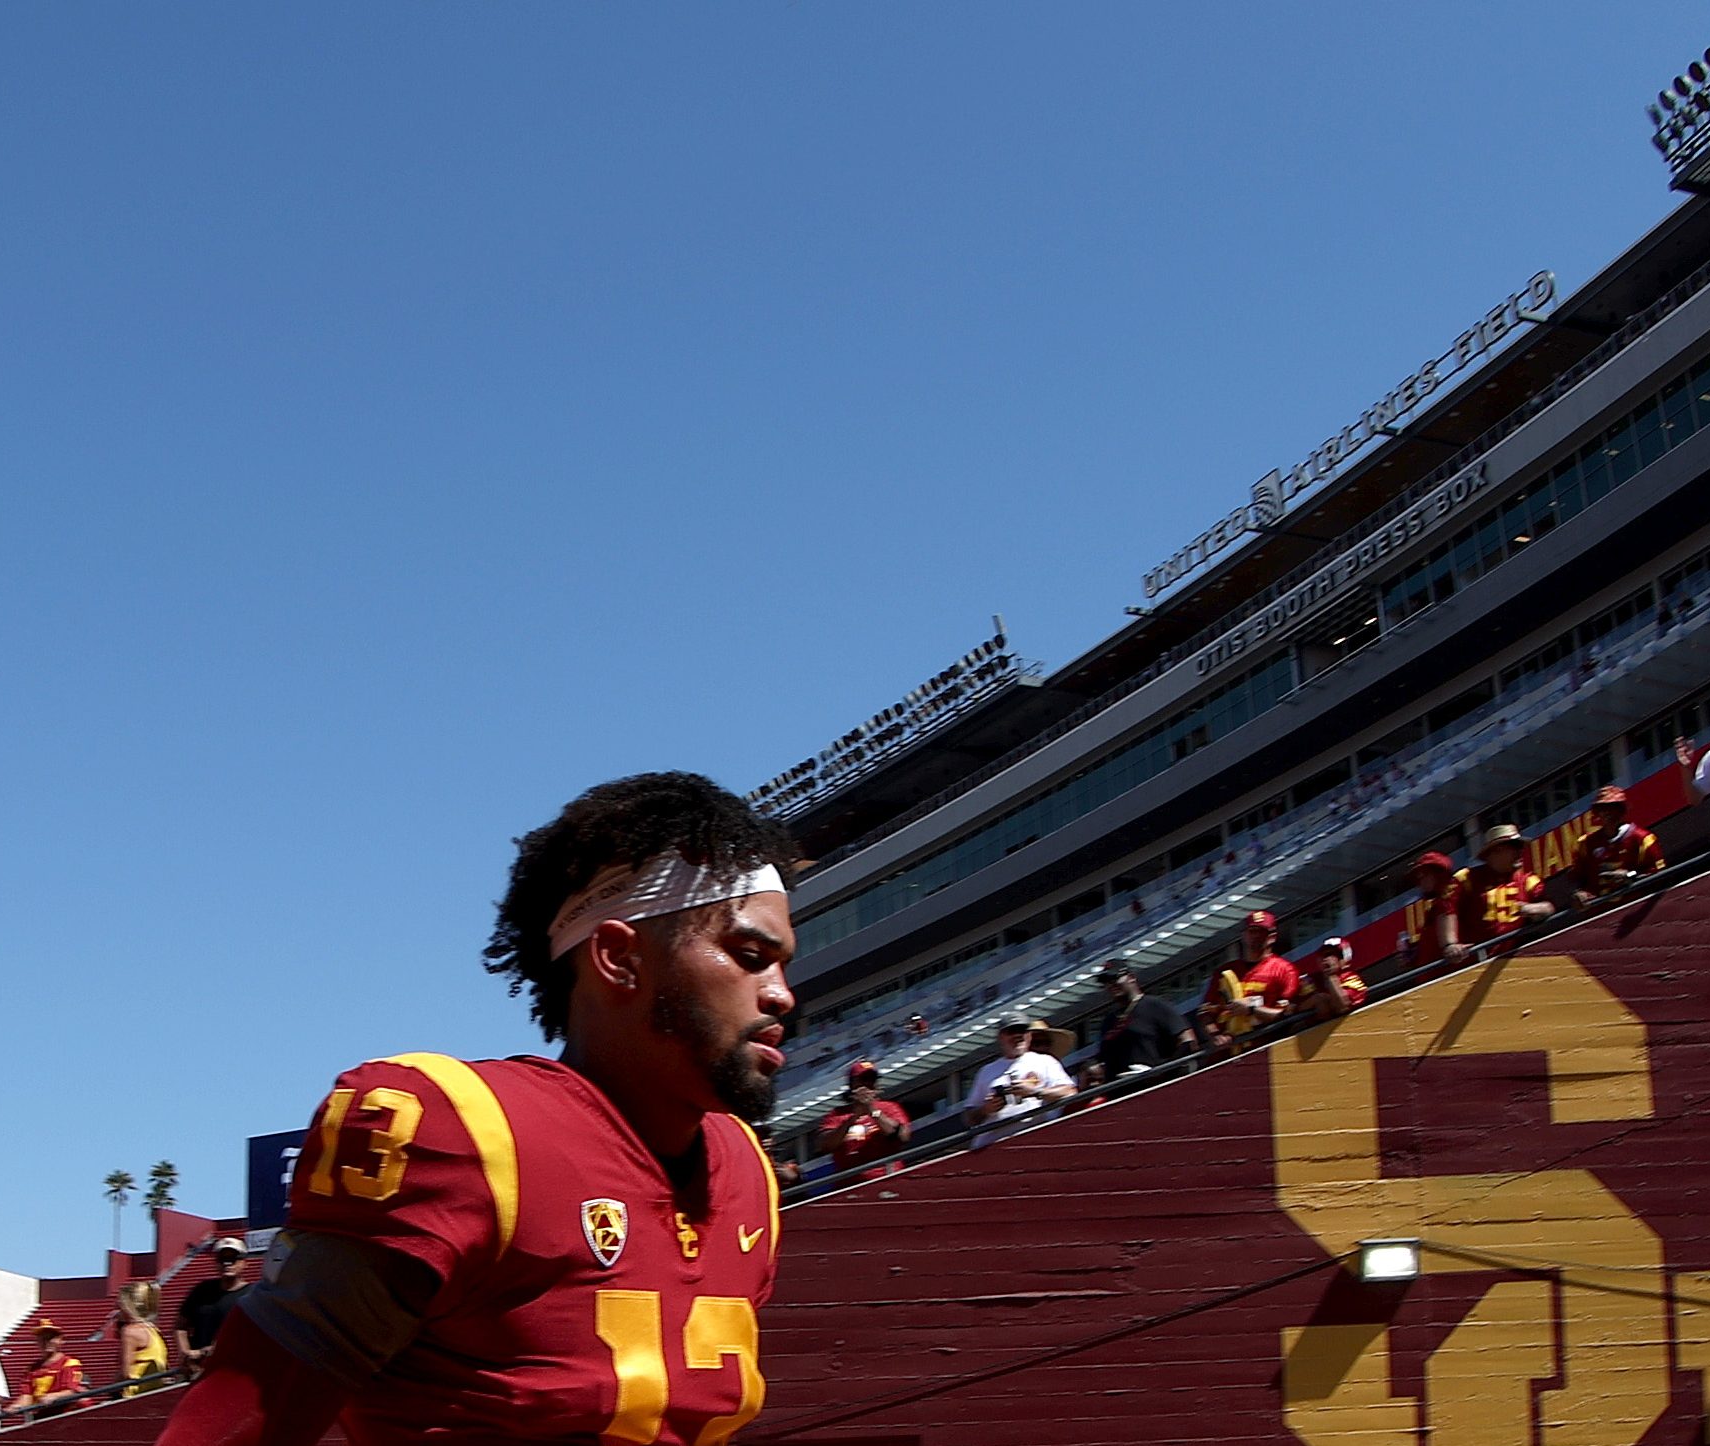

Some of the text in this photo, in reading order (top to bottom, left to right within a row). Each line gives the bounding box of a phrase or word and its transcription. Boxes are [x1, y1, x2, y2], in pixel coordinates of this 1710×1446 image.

[1142, 269, 1555, 597] UNITED AIRLINES FIELD
[1195, 462, 1489, 676] OTIS BOOTH PRESS BOX
[309, 1088, 424, 1201] 13
